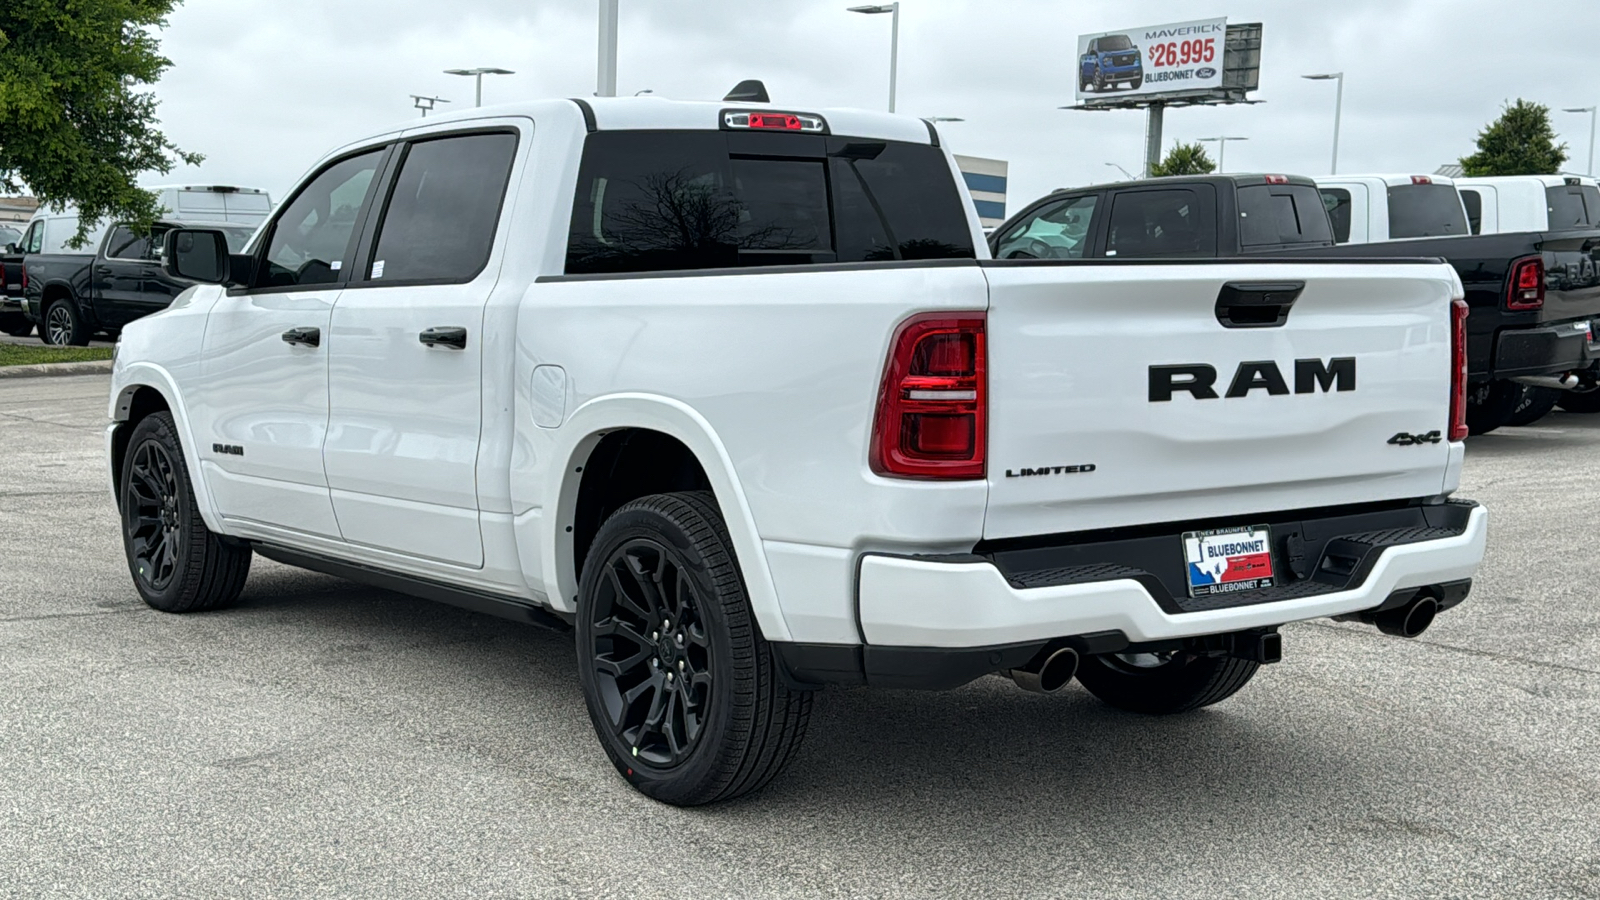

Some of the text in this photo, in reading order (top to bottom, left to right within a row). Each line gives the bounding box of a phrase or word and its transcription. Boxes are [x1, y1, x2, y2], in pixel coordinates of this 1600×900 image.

[1145, 24, 1221, 39] MAVERICK
[1148, 38, 1215, 68] $26,995
[1145, 69, 1194, 83] BLUEBONNET
[1149, 357, 1356, 402] RAM
[212, 443, 244, 456] RAM
[1005, 463, 1096, 478] LIMITED
[1216, 526, 1252, 535] BRAUNFELS
[1208, 540, 1264, 557] BLUEBONNET
[1210, 580, 1257, 593] BLUEBONNET
